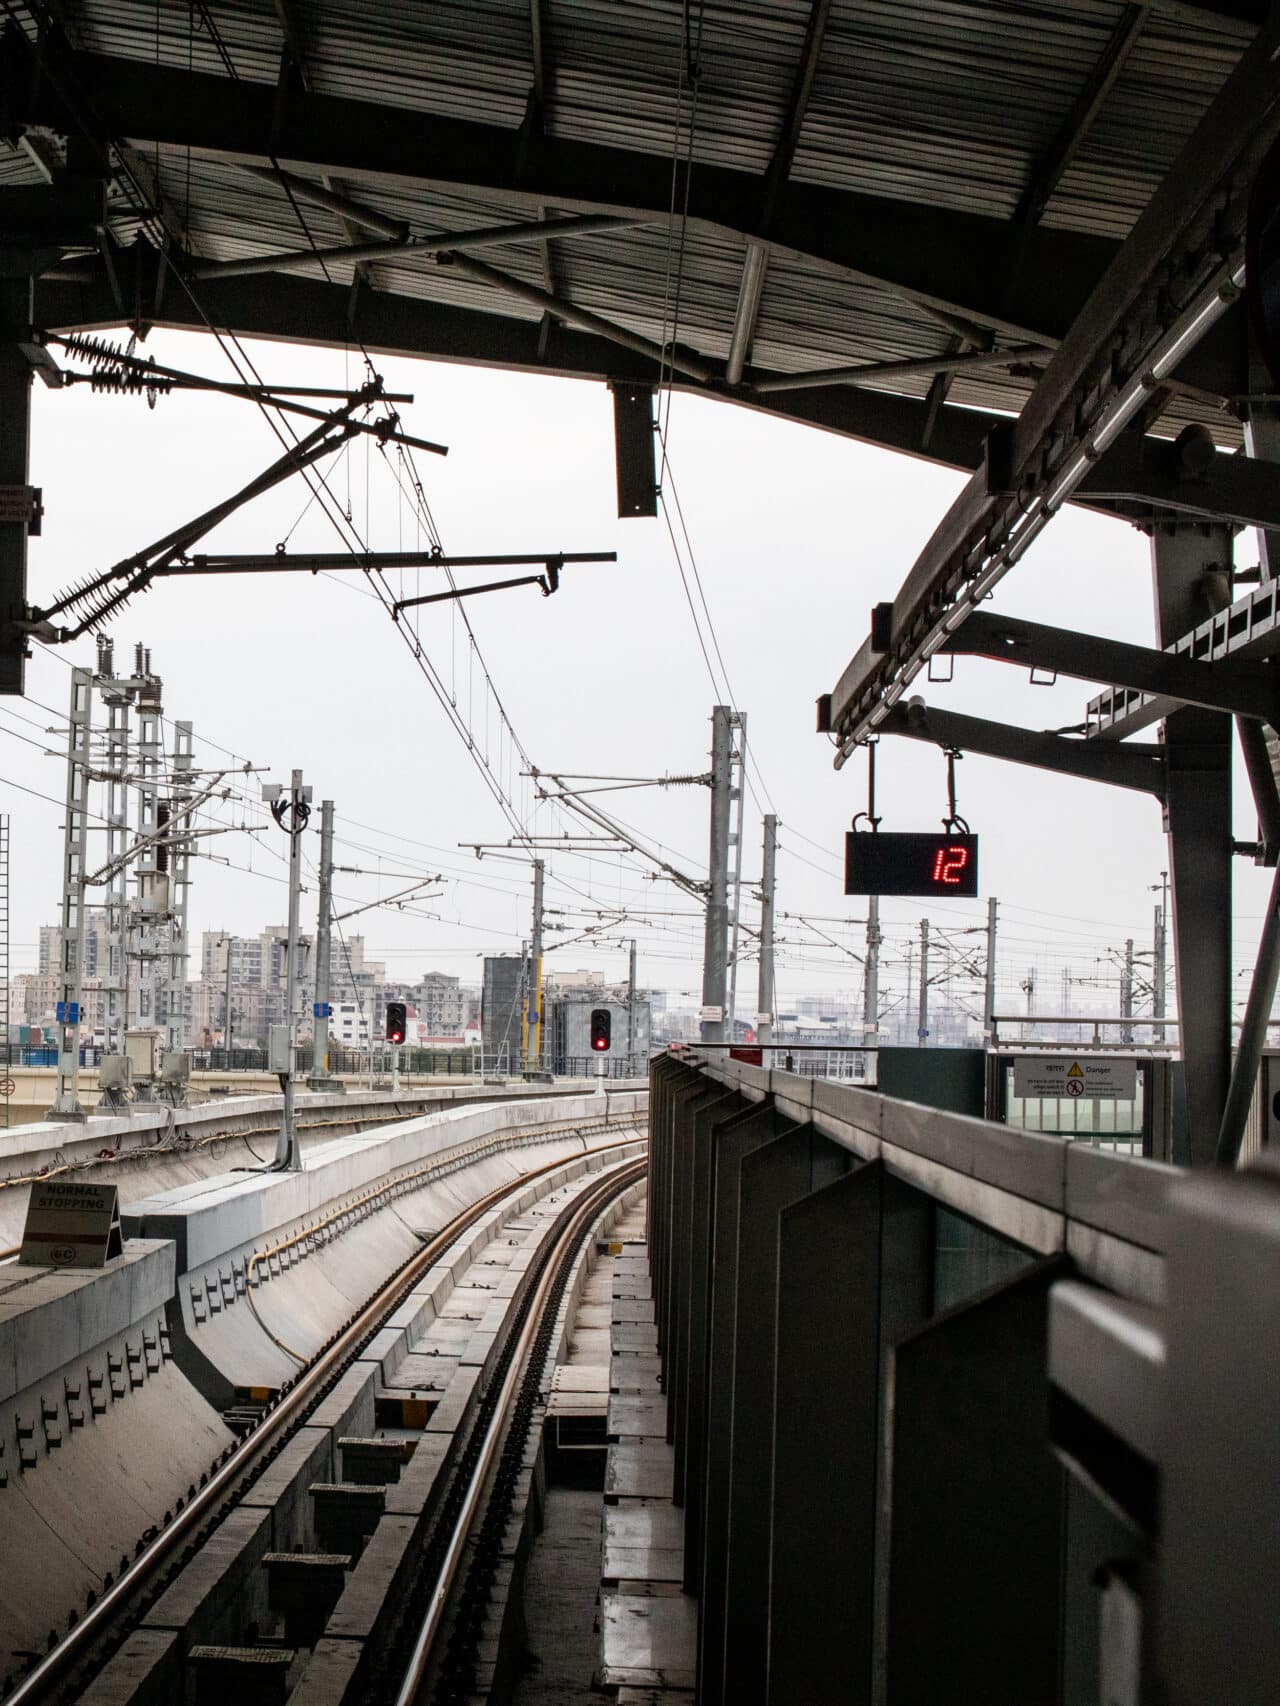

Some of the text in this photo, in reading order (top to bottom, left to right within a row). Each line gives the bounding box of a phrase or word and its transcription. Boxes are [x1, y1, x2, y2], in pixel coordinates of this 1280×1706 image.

[933, 846, 968, 883] 12
[1086, 1066, 1111, 1074] Danger
[47, 1185, 100, 1196] NORMAL
[39, 1198, 104, 1209] STOPPING
